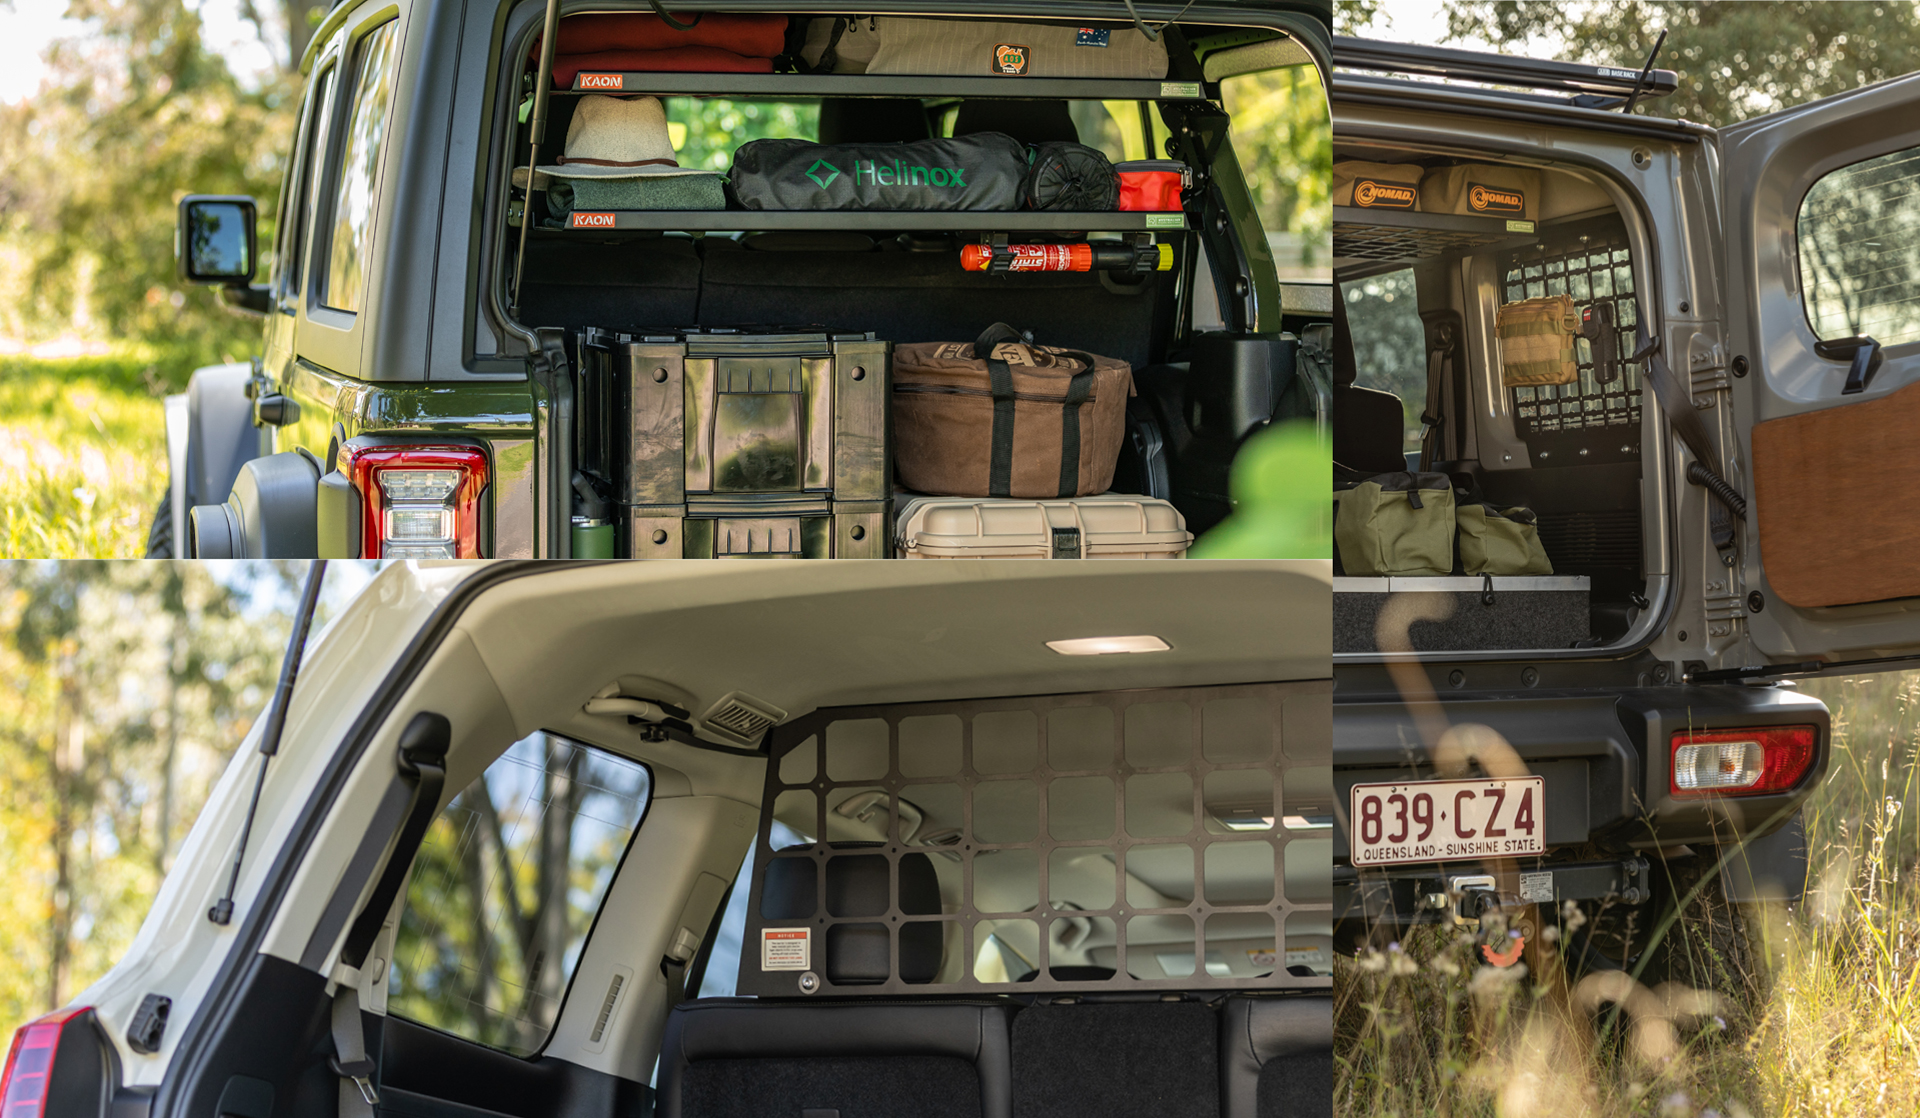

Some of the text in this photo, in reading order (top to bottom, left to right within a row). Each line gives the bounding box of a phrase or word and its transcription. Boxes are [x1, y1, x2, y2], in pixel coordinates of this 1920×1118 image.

[1004, 55, 1019, 63] AOS
[581, 76, 621, 87] KAON
[855, 159, 967, 187] Helinox
[574, 215, 614, 226] KAON
[1364, 845, 1436, 860] QUEENSLAND
[1446, 841, 1499, 855] SUNSHINE
[1504, 839, 1535, 852] STATE
